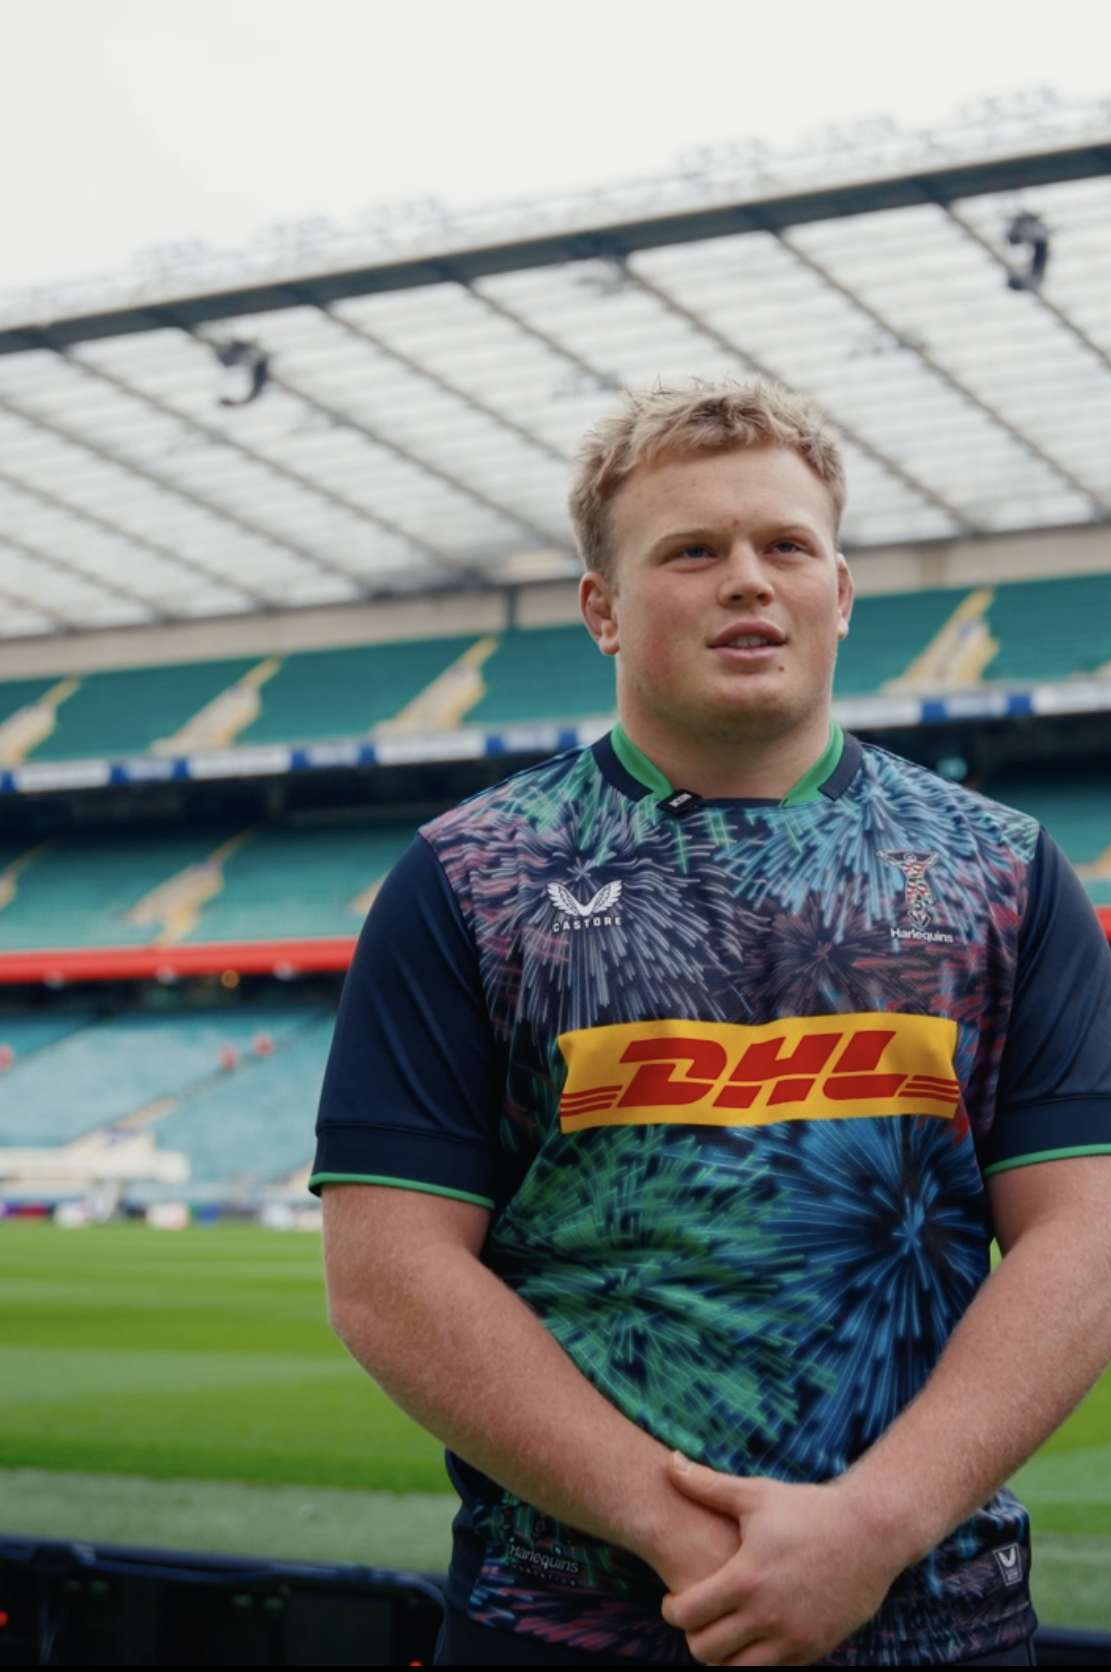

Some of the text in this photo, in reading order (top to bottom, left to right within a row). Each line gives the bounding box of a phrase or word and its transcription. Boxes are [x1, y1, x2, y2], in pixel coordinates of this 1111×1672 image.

[552, 916, 622, 933] CASTORE
[890, 927, 954, 943] Harlequins
[616, 1030, 908, 1109] DHL
[509, 1543, 579, 1574] Harlequins
